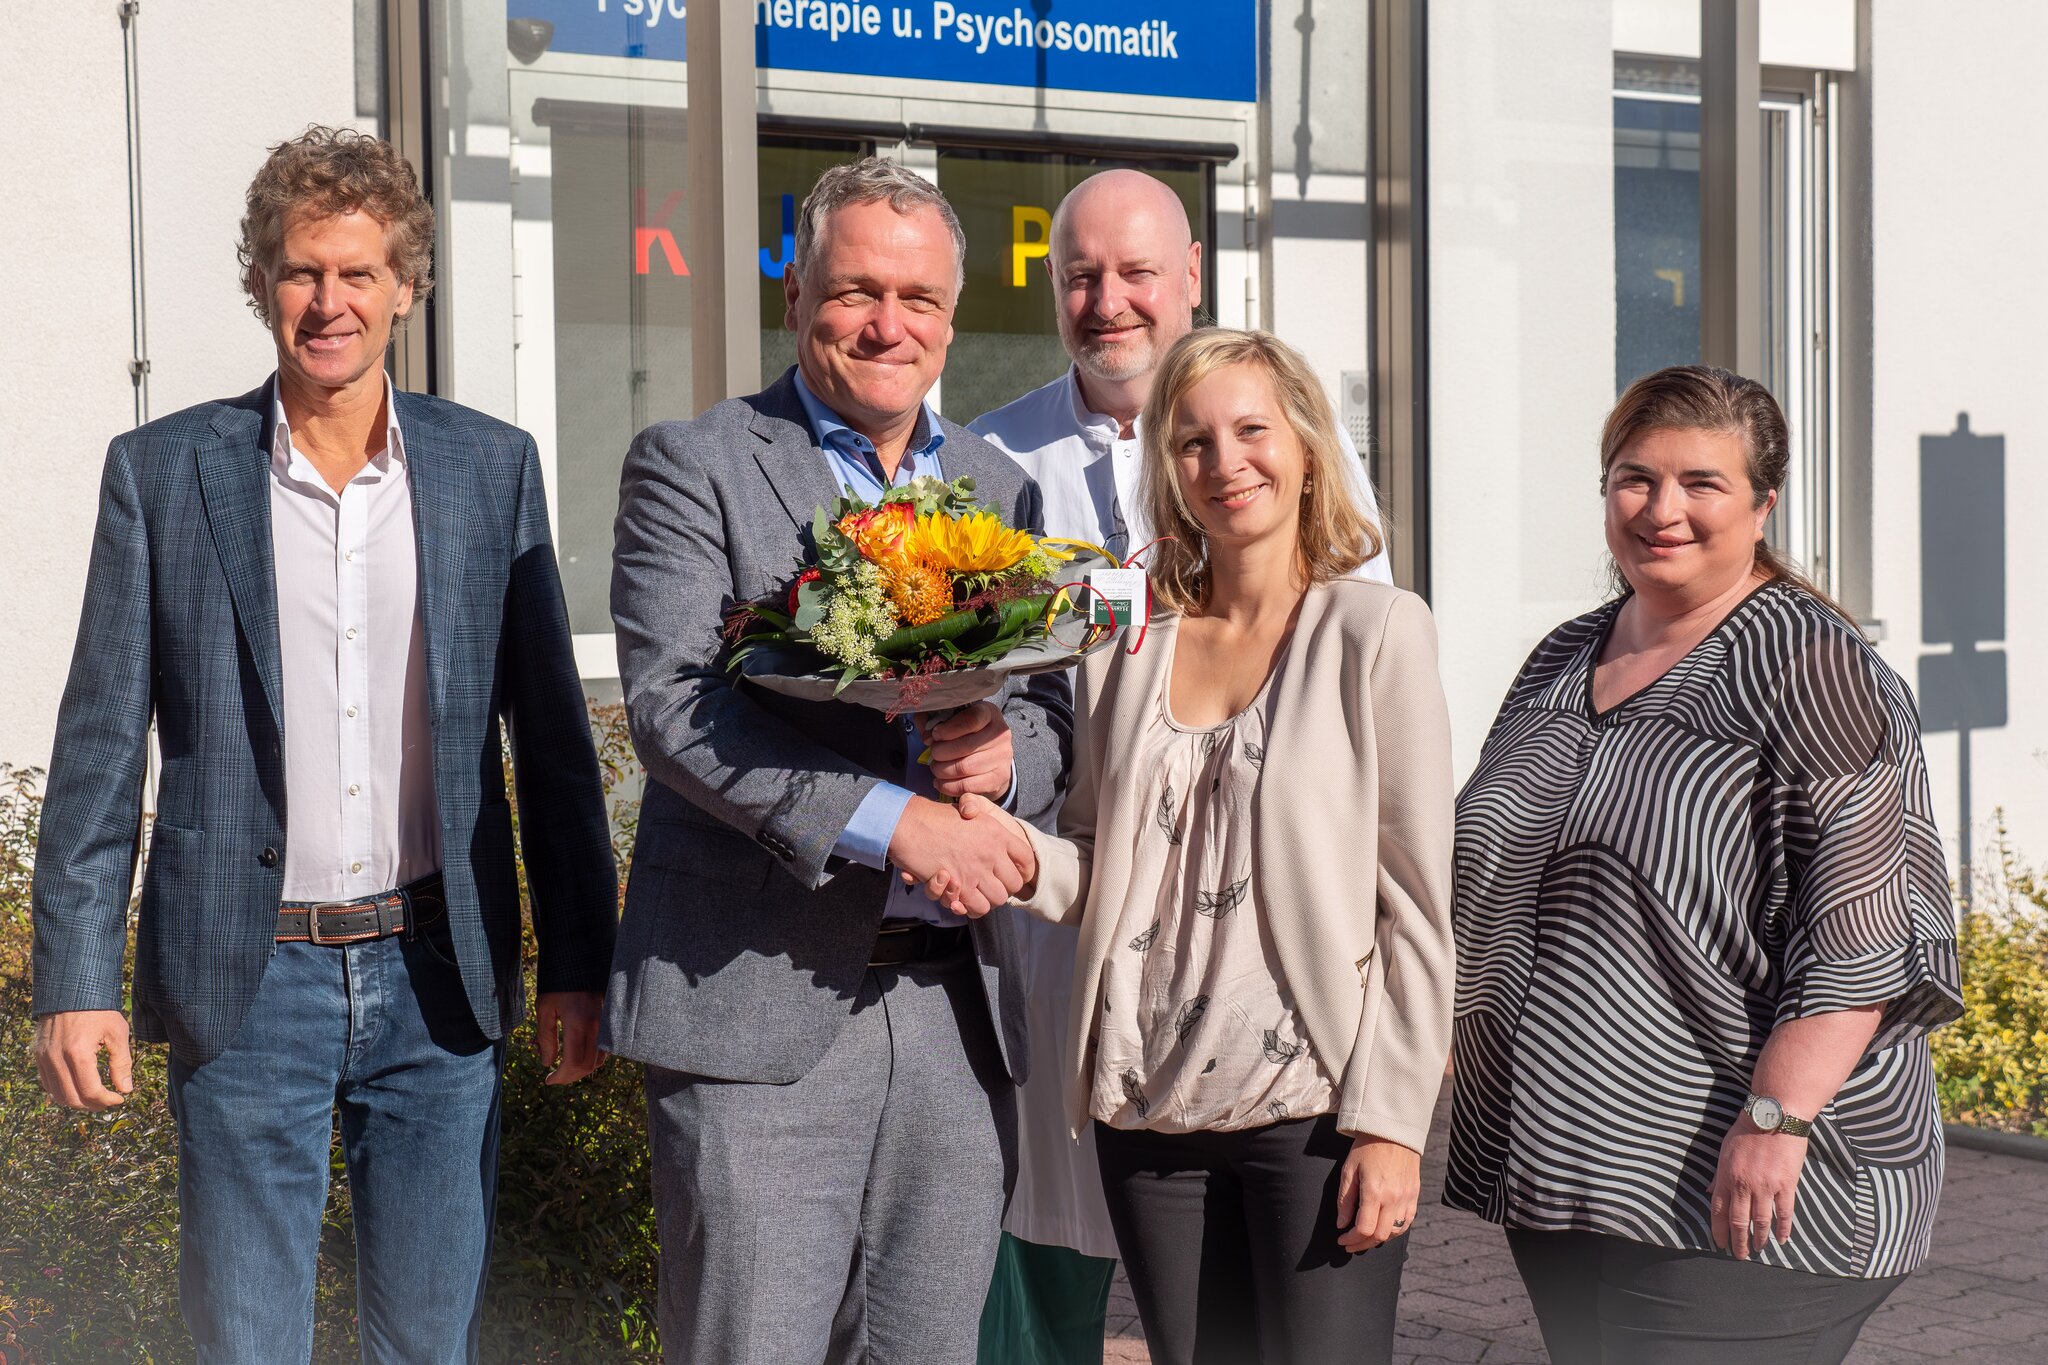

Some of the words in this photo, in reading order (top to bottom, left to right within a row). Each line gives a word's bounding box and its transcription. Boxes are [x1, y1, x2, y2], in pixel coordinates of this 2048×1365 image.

[892, 8, 923, 39] u.
[933, 1, 1179, 59] Psychosomatik
[635, 187, 691, 276] K
[758, 194, 795, 279] J
[1012, 205, 1052, 287] P
